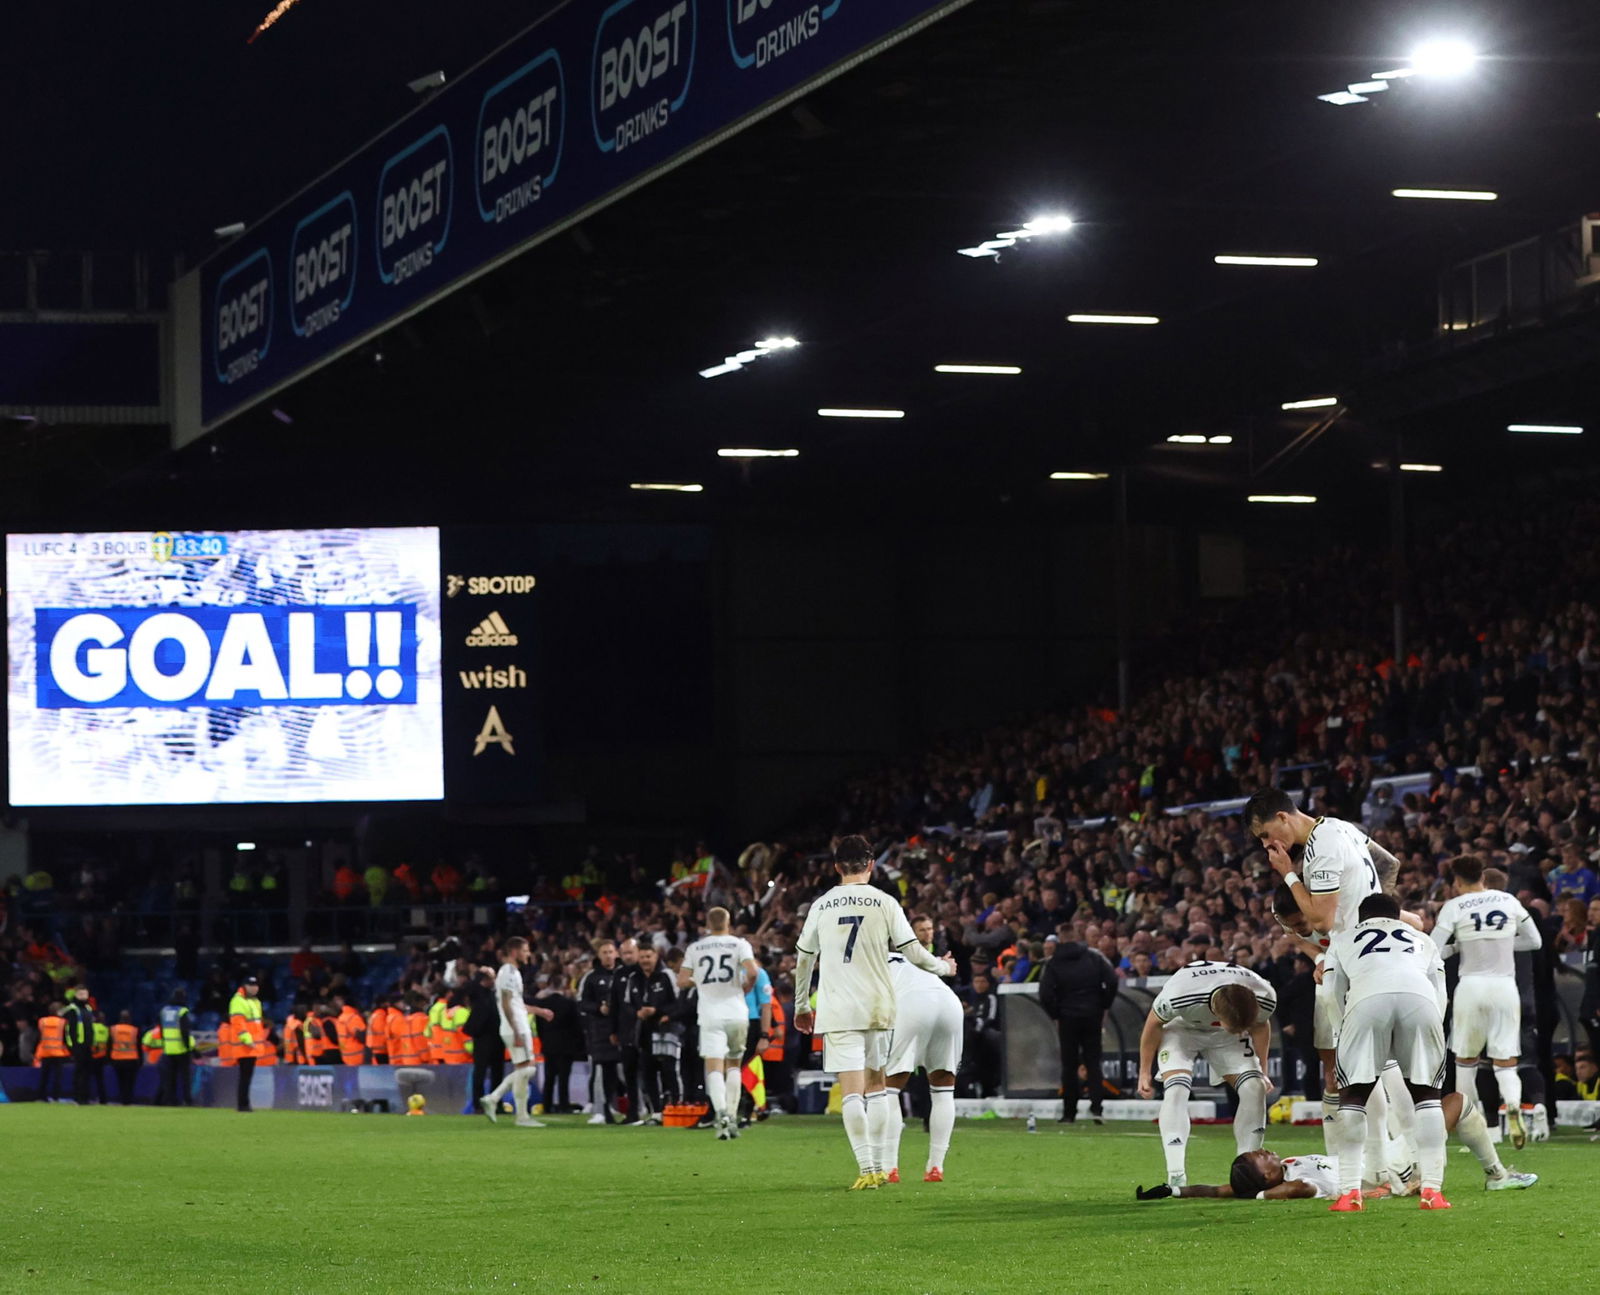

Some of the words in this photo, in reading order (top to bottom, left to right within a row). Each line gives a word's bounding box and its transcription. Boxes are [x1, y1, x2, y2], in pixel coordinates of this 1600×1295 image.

[600, 1, 688, 112] BOOST
[756, 4, 820, 69] DRINKS
[483, 86, 557, 184] BOOST
[615, 98, 669, 153] DRINKS
[382, 159, 447, 248] BOOST
[495, 174, 541, 224] DRINKS
[296, 223, 351, 303] BOOST
[393, 240, 433, 285] DRINKS
[219, 278, 268, 352] BOOST
[304, 298, 340, 338] DRINKS
[24, 542, 63, 556] LUFC
[68, 542, 77, 555] 4
[91, 541, 100, 555] 3
[104, 541, 147, 555] BOUR
[175, 538, 223, 556] 83:40
[467, 575, 536, 595] SBOTOP
[50, 611, 403, 702] GOAL!!
[465, 634, 519, 647] adidas
[459, 664, 527, 689] wish
[819, 896, 881, 911] AARONSON
[1470, 910, 1508, 931] 19
[838, 915, 864, 964] 7
[698, 954, 734, 984] 25
